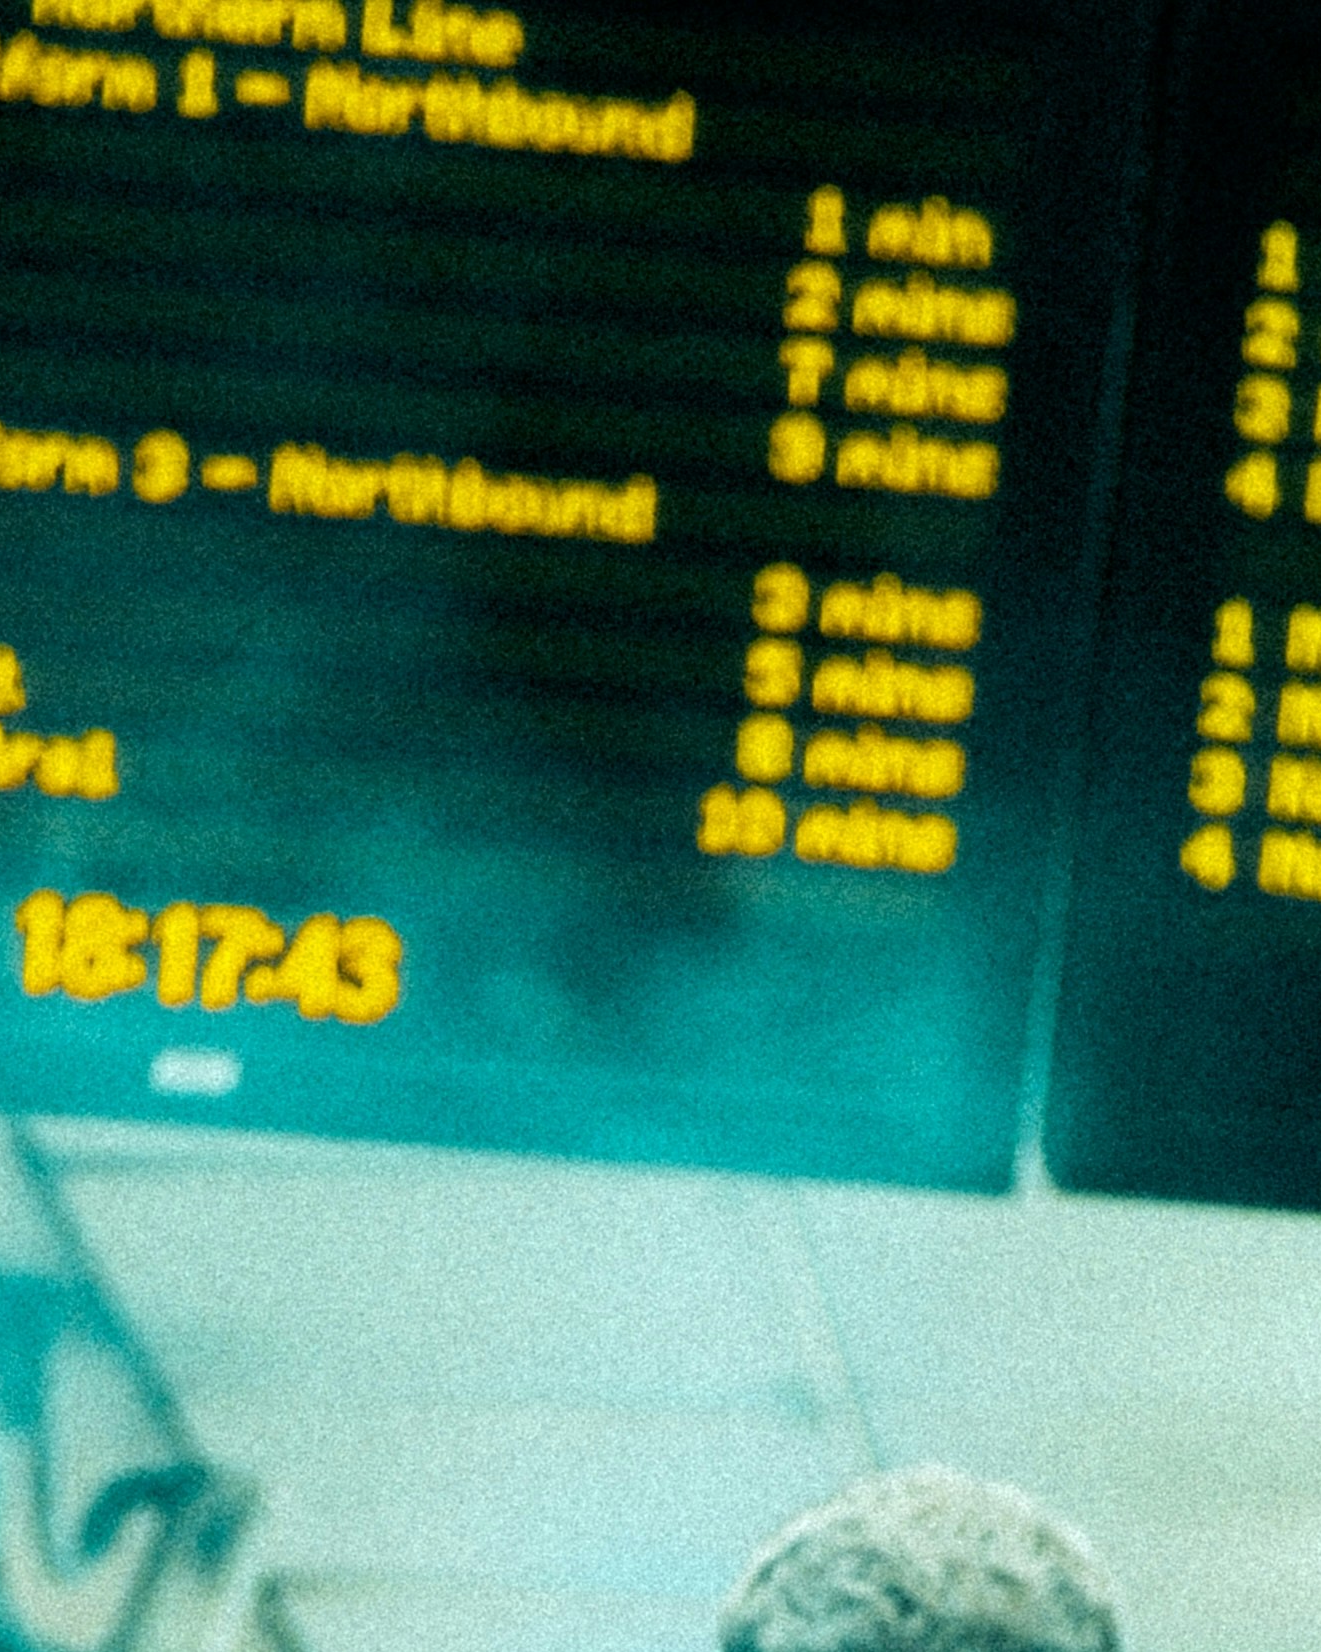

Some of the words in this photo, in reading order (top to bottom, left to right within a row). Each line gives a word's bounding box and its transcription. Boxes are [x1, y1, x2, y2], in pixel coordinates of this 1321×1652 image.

[357, 0, 528, 71] Line
[174, 46, 222, 121] 1
[300, 57, 699, 165] Northbound
[801, 183, 850, 258] 1
[863, 194, 996, 270] min
[1255, 221, 1302, 295] 1
[780, 258, 846, 335] 2
[848, 270, 1019, 349] mins
[1239, 296, 1303, 372] 2
[776, 333, 838, 409] 7
[840, 344, 1011, 426] mins
[1231, 371, 1295, 446] 3
[129, 427, 193, 506] 3
[265, 440, 661, 547] Northbound
[832, 423, 1002, 501] mins
[1222, 449, 1284, 520] 4
[815, 571, 985, 653] mins
[1209, 597, 1258, 671] 1
[808, 646, 978, 727] mins
[1194, 669, 1259, 745] 2
[799, 721, 969, 802] mins
[1185, 743, 1250, 820] 3
[791, 795, 960, 876] mins
[1177, 820, 1239, 892] 4
[12, 887, 405, 1027] 18:17:43
